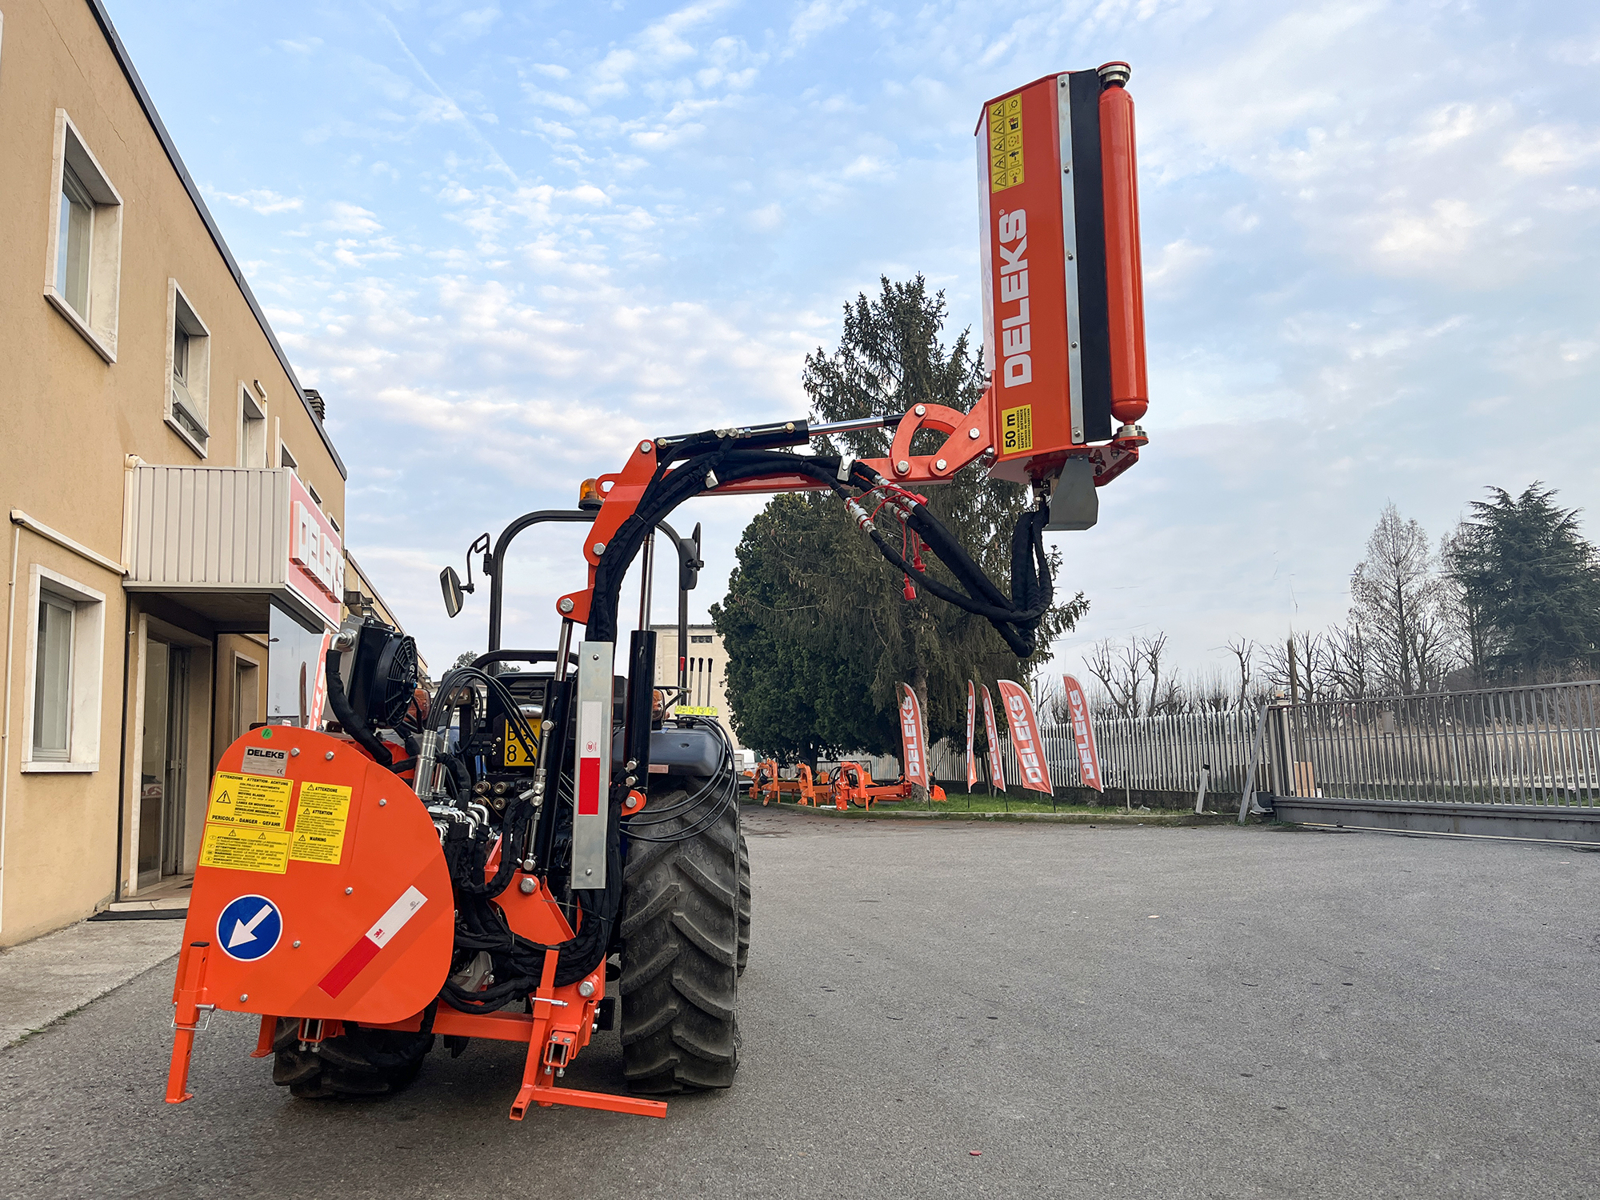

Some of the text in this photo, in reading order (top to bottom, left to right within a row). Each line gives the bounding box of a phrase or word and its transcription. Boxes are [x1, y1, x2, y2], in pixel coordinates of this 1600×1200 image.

[999, 209, 1032, 389] DELEKS
[1005, 414, 1016, 448] 50 m
[247, 749, 284, 760] DELEKS
[902, 696, 920, 776] DELEKS
[1008, 695, 1042, 784] DELEKS
[1070, 690, 1095, 780] DELEKS
